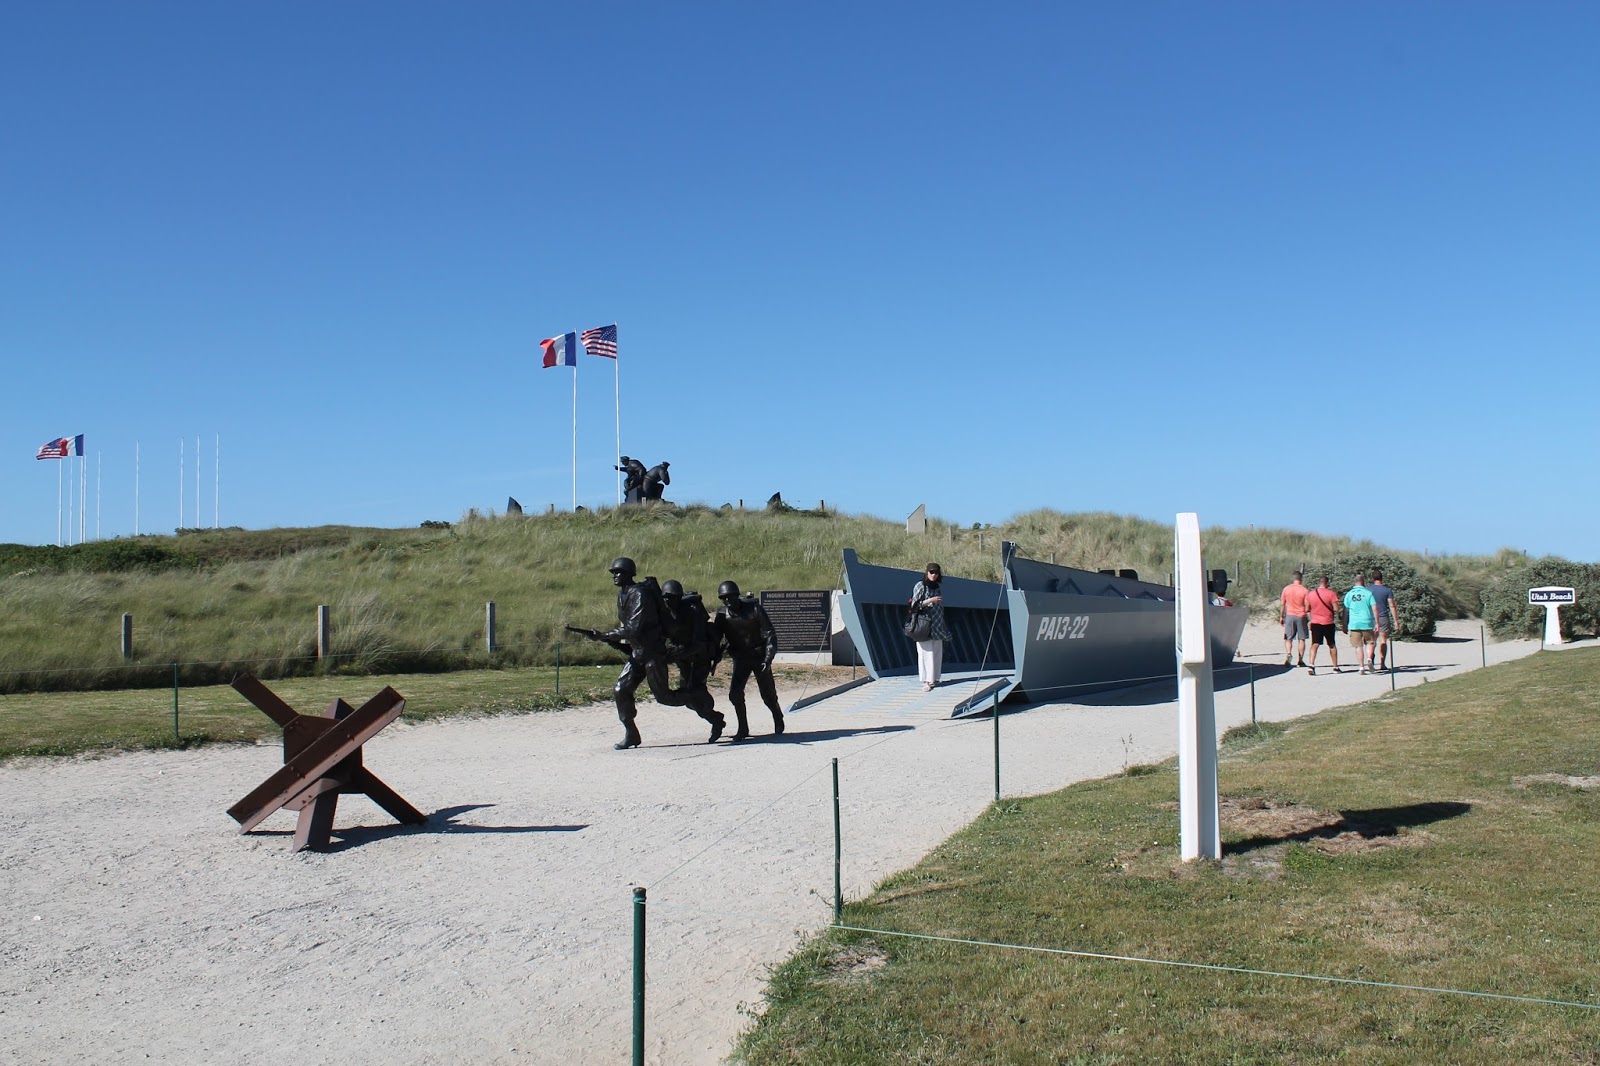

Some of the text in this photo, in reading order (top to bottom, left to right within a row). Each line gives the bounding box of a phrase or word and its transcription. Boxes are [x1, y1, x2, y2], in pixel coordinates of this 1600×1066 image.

[1531, 592, 1572, 600] Utah Beach
[1036, 615, 1090, 641] PA13-22
